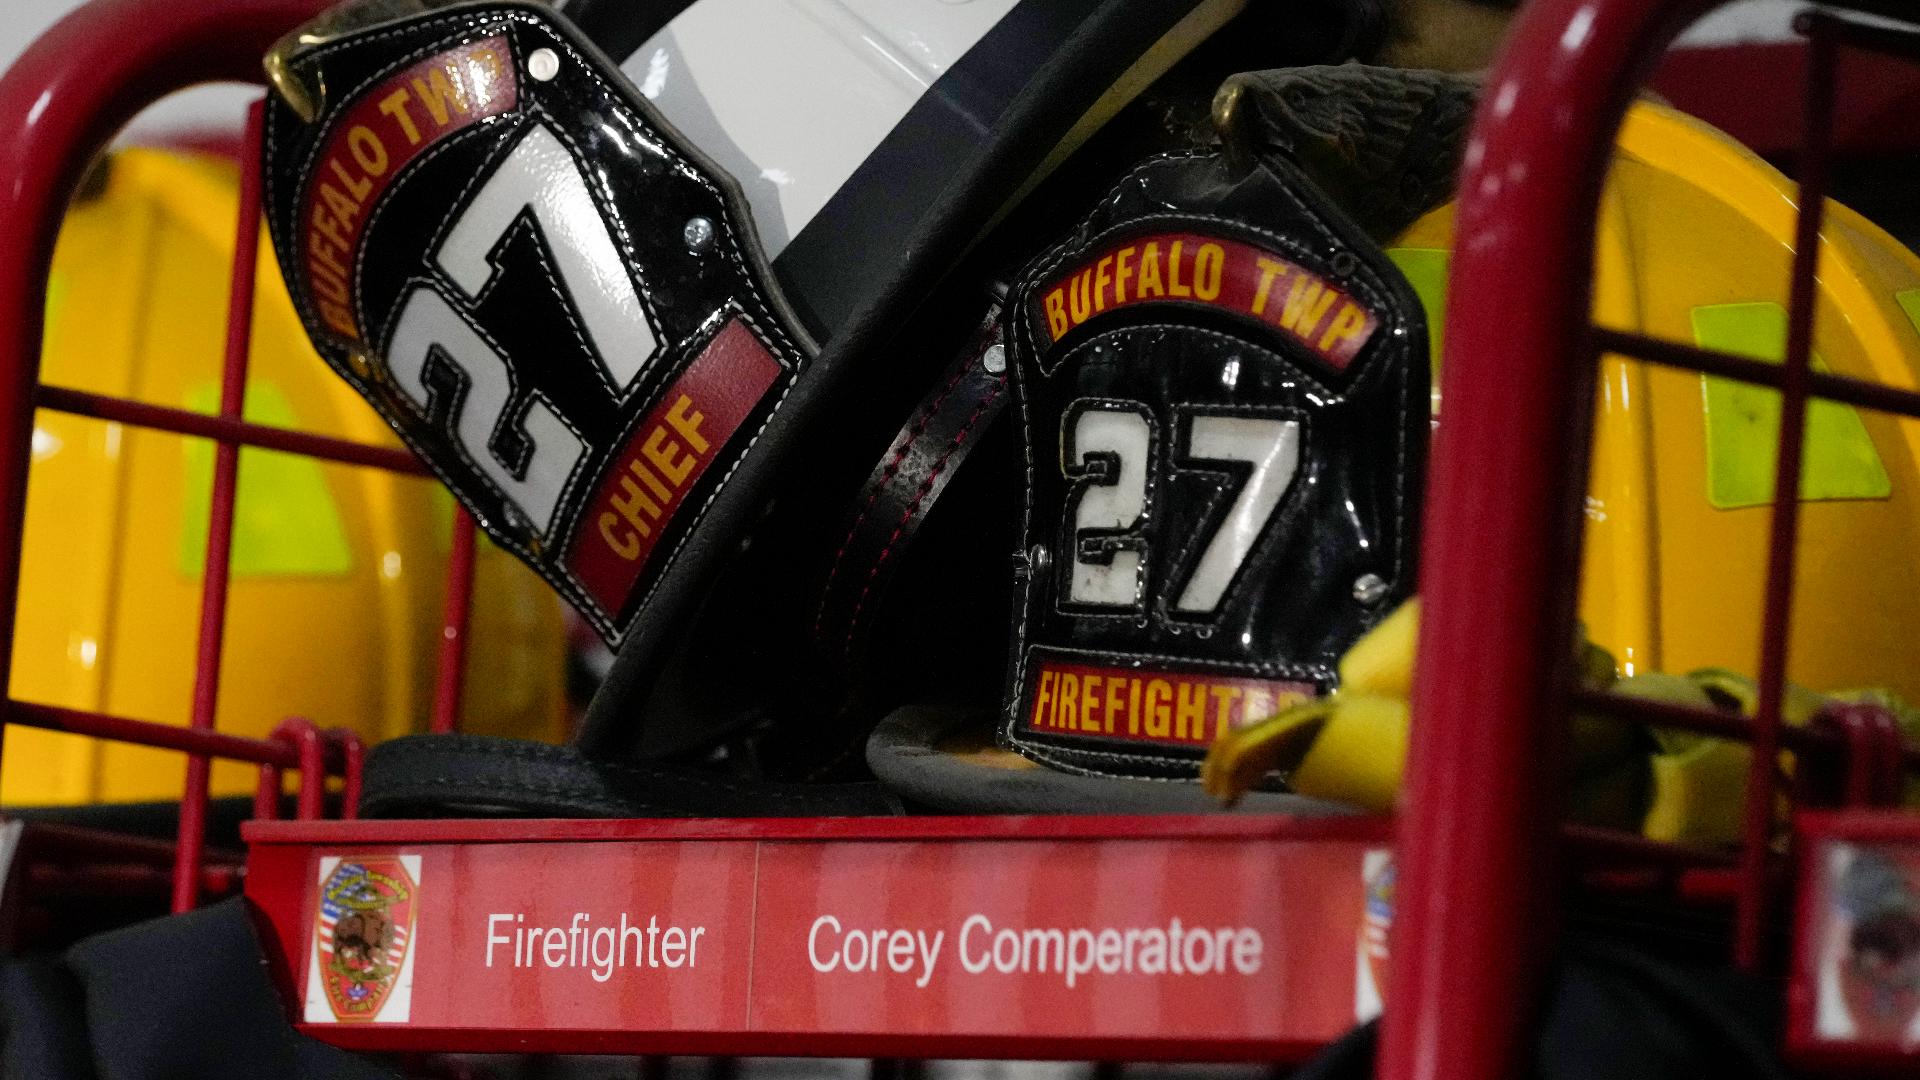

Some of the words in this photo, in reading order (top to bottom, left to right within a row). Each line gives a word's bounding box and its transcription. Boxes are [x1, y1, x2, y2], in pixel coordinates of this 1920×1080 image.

[311, 126, 388, 338] BUFFALO
[379, 48, 503, 146] TWP
[387, 122, 658, 542] 27
[1045, 240, 1225, 343] BUFFALO
[1250, 256, 1370, 352] TWP
[600, 394, 710, 562] CHIEF
[1070, 409, 1300, 613] 27
[486, 912, 706, 982] Firefighter
[807, 915, 944, 987] Corey
[958, 914, 1263, 987] Comperatore
